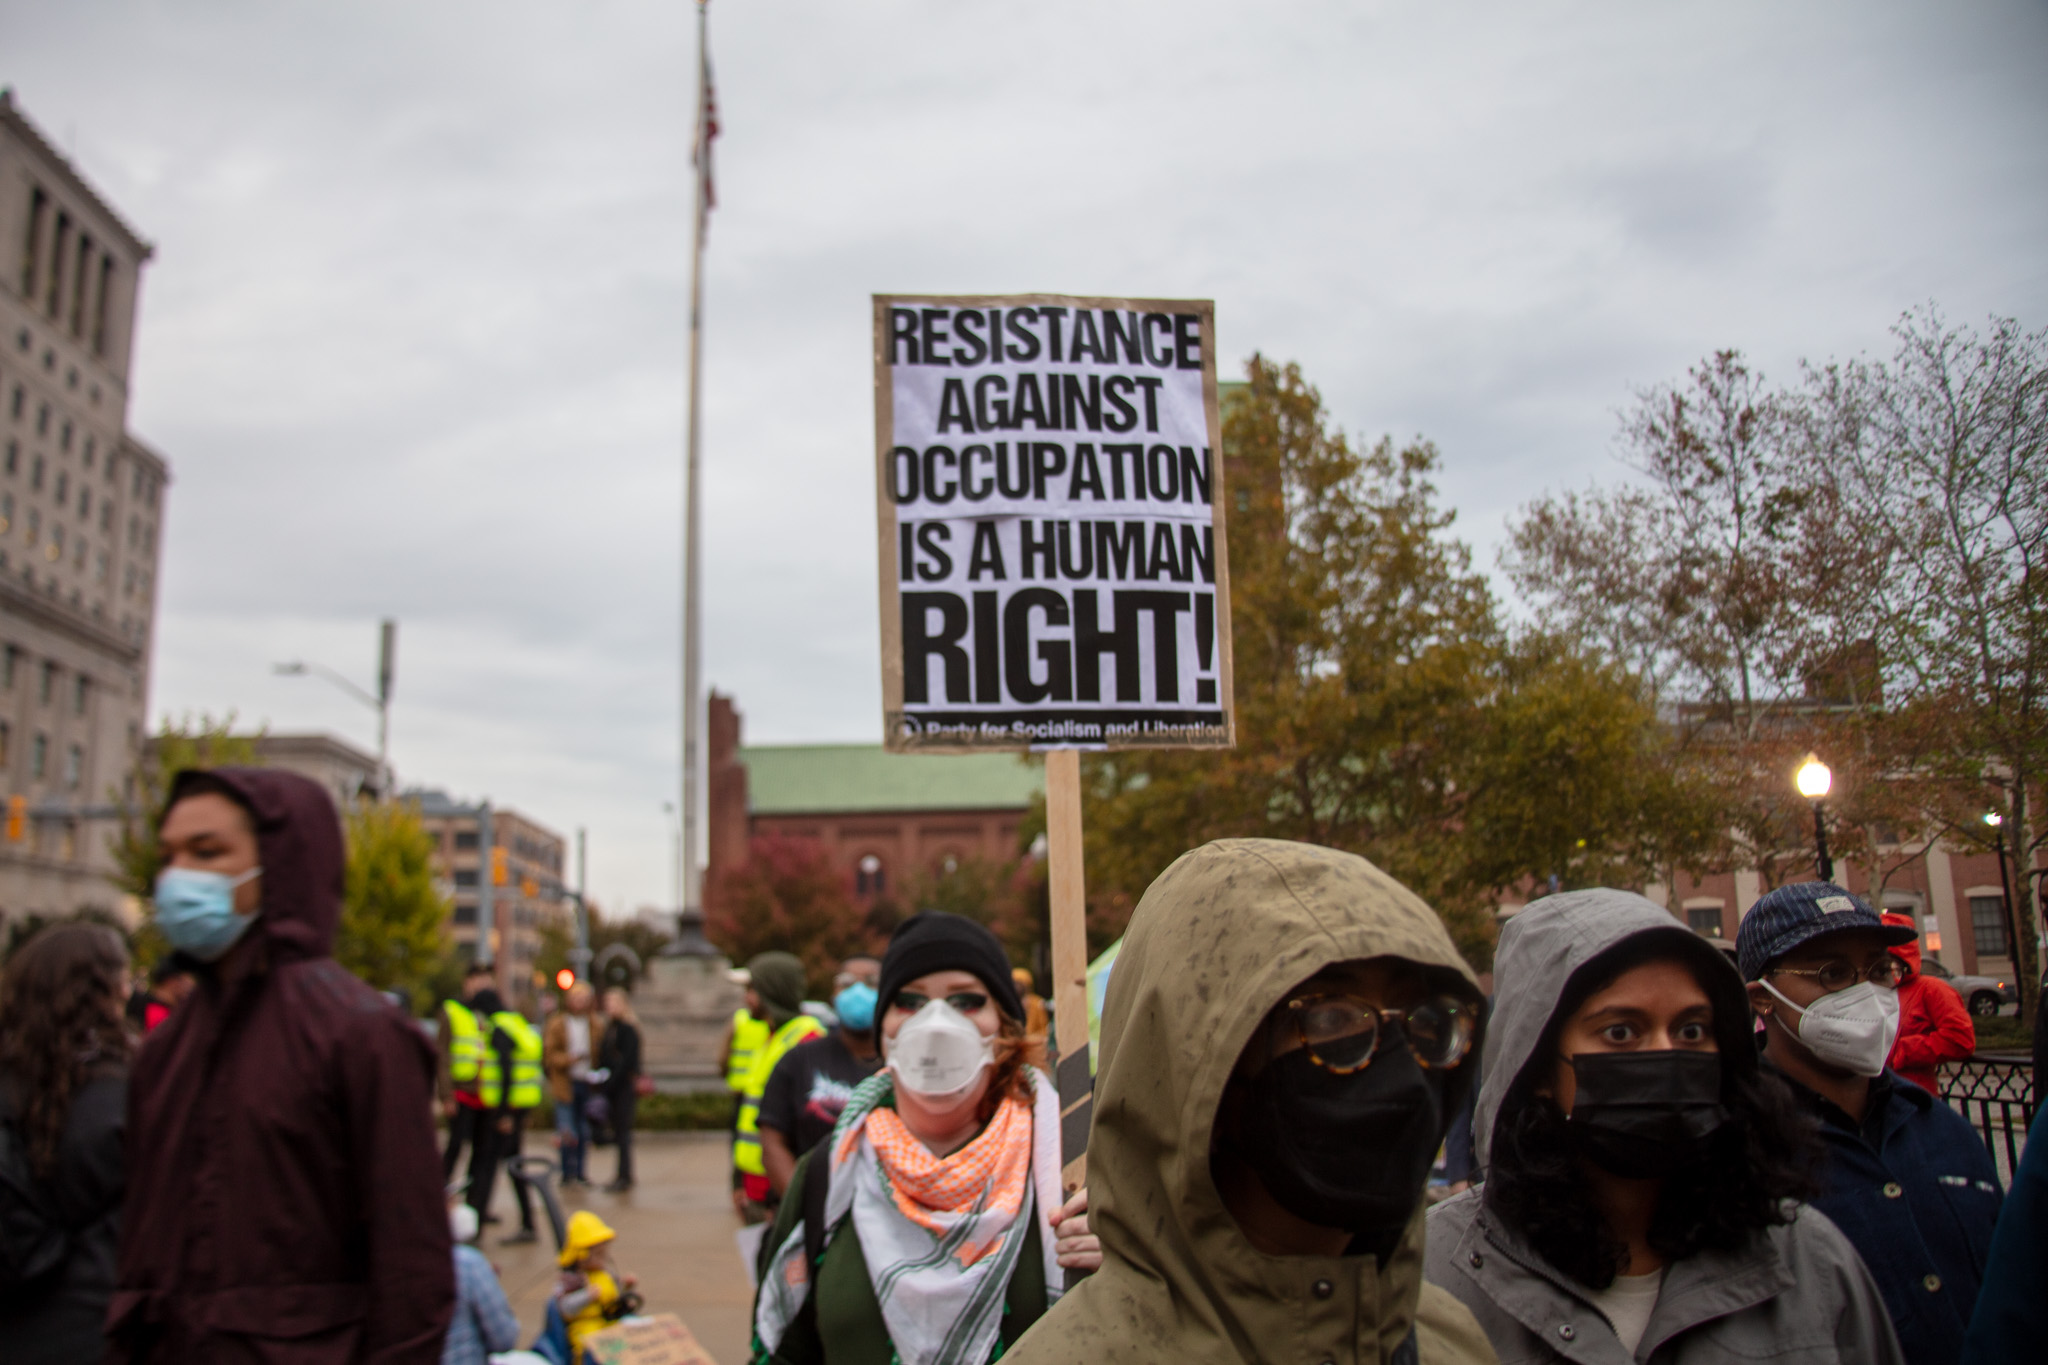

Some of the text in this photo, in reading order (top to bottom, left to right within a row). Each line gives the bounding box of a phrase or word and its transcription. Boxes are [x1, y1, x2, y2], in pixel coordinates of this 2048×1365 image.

[885, 306, 1205, 370] RESISTANCE
[937, 373, 1163, 433] AGAINST
[886, 441, 1214, 505] OCCUPATION
[900, 520, 1215, 583] IS A HUMAN
[900, 586, 1216, 704] RIGHT!
[980, 721, 1008, 738] for
[1012, 720, 1101, 738] Socialism
[1105, 720, 1139, 738] and
[1143, 720, 1226, 738] Liberation
